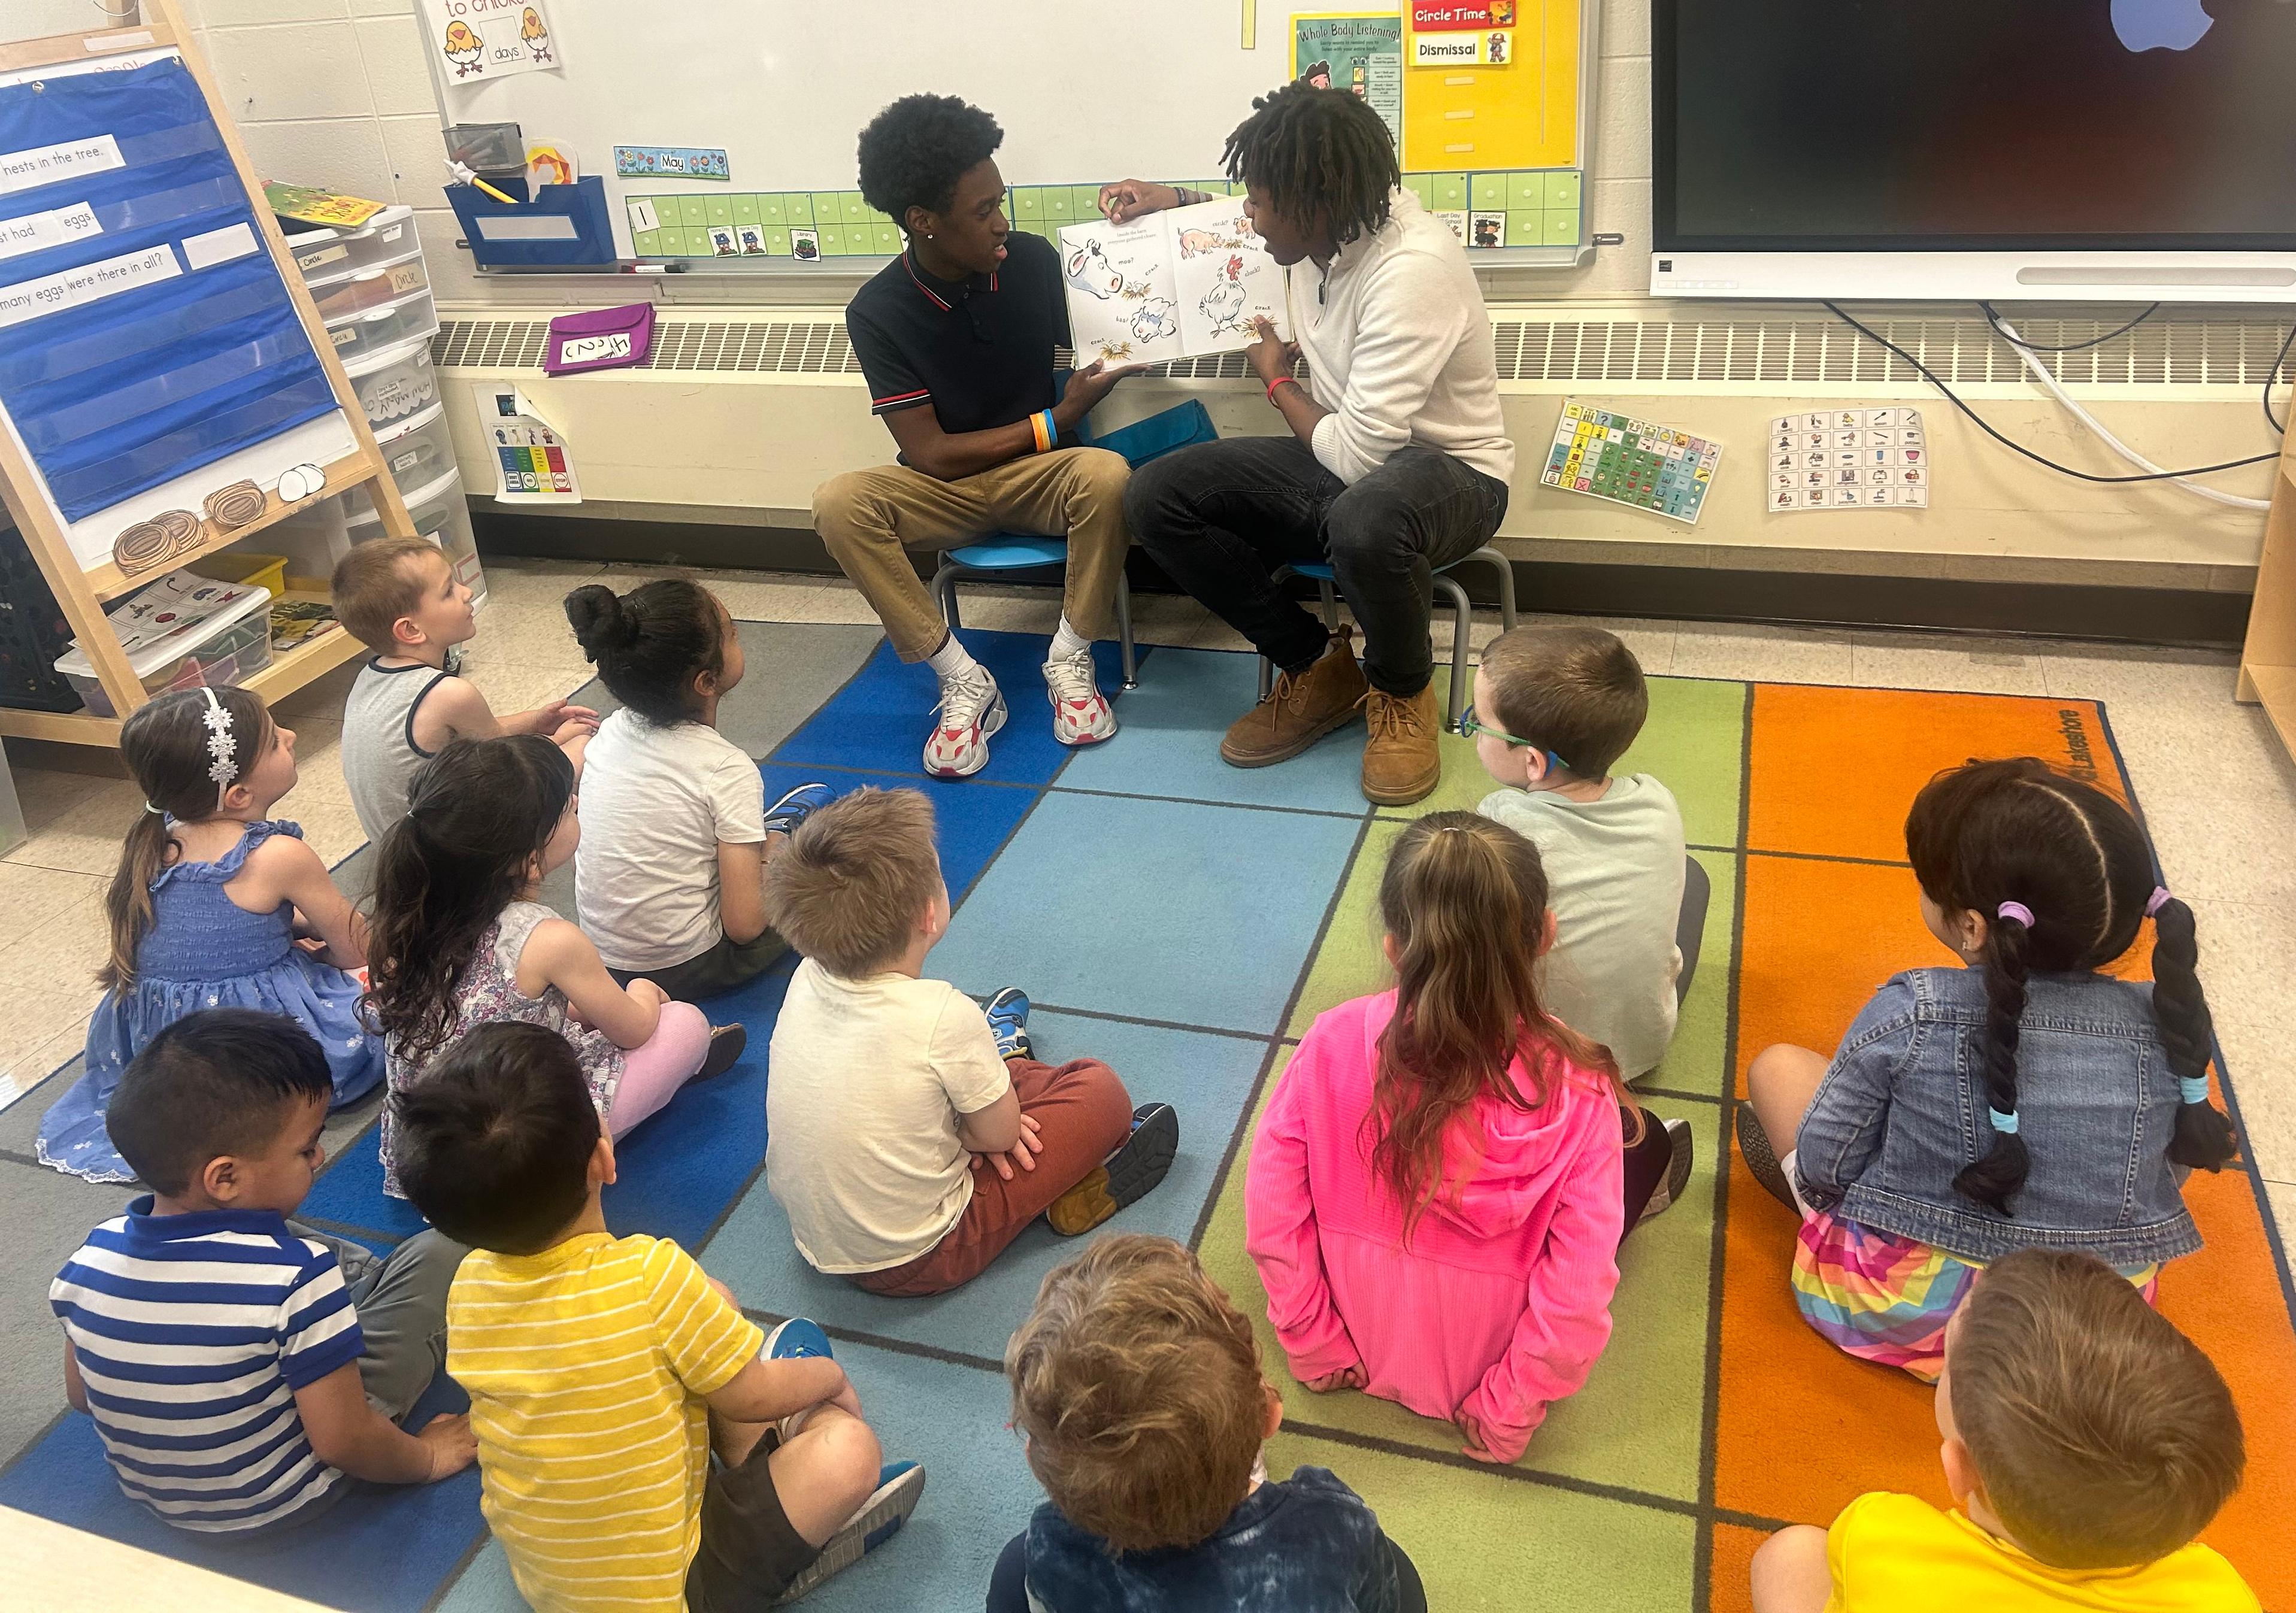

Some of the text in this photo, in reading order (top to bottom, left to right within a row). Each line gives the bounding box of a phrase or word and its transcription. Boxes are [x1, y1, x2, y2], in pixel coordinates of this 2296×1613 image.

[446, 0, 467, 17] to
[1415, 8, 1486, 22] Circle Time
[1299, 23, 1401, 42] Whole Body Listening!
[495, 47, 519, 61] days
[1420, 44, 1476, 56] Dismissal
[4, 148, 104, 175] nests in the tree.
[662, 155, 684, 171] May
[9, 223, 35, 239] had
[64, 212, 95, 229] eggs.
[304, 256, 322, 266] Circle
[1145, 263, 1159, 276] crack
[0, 253, 163, 310] many eggs were there in all?
[395, 272, 417, 290] Circle
